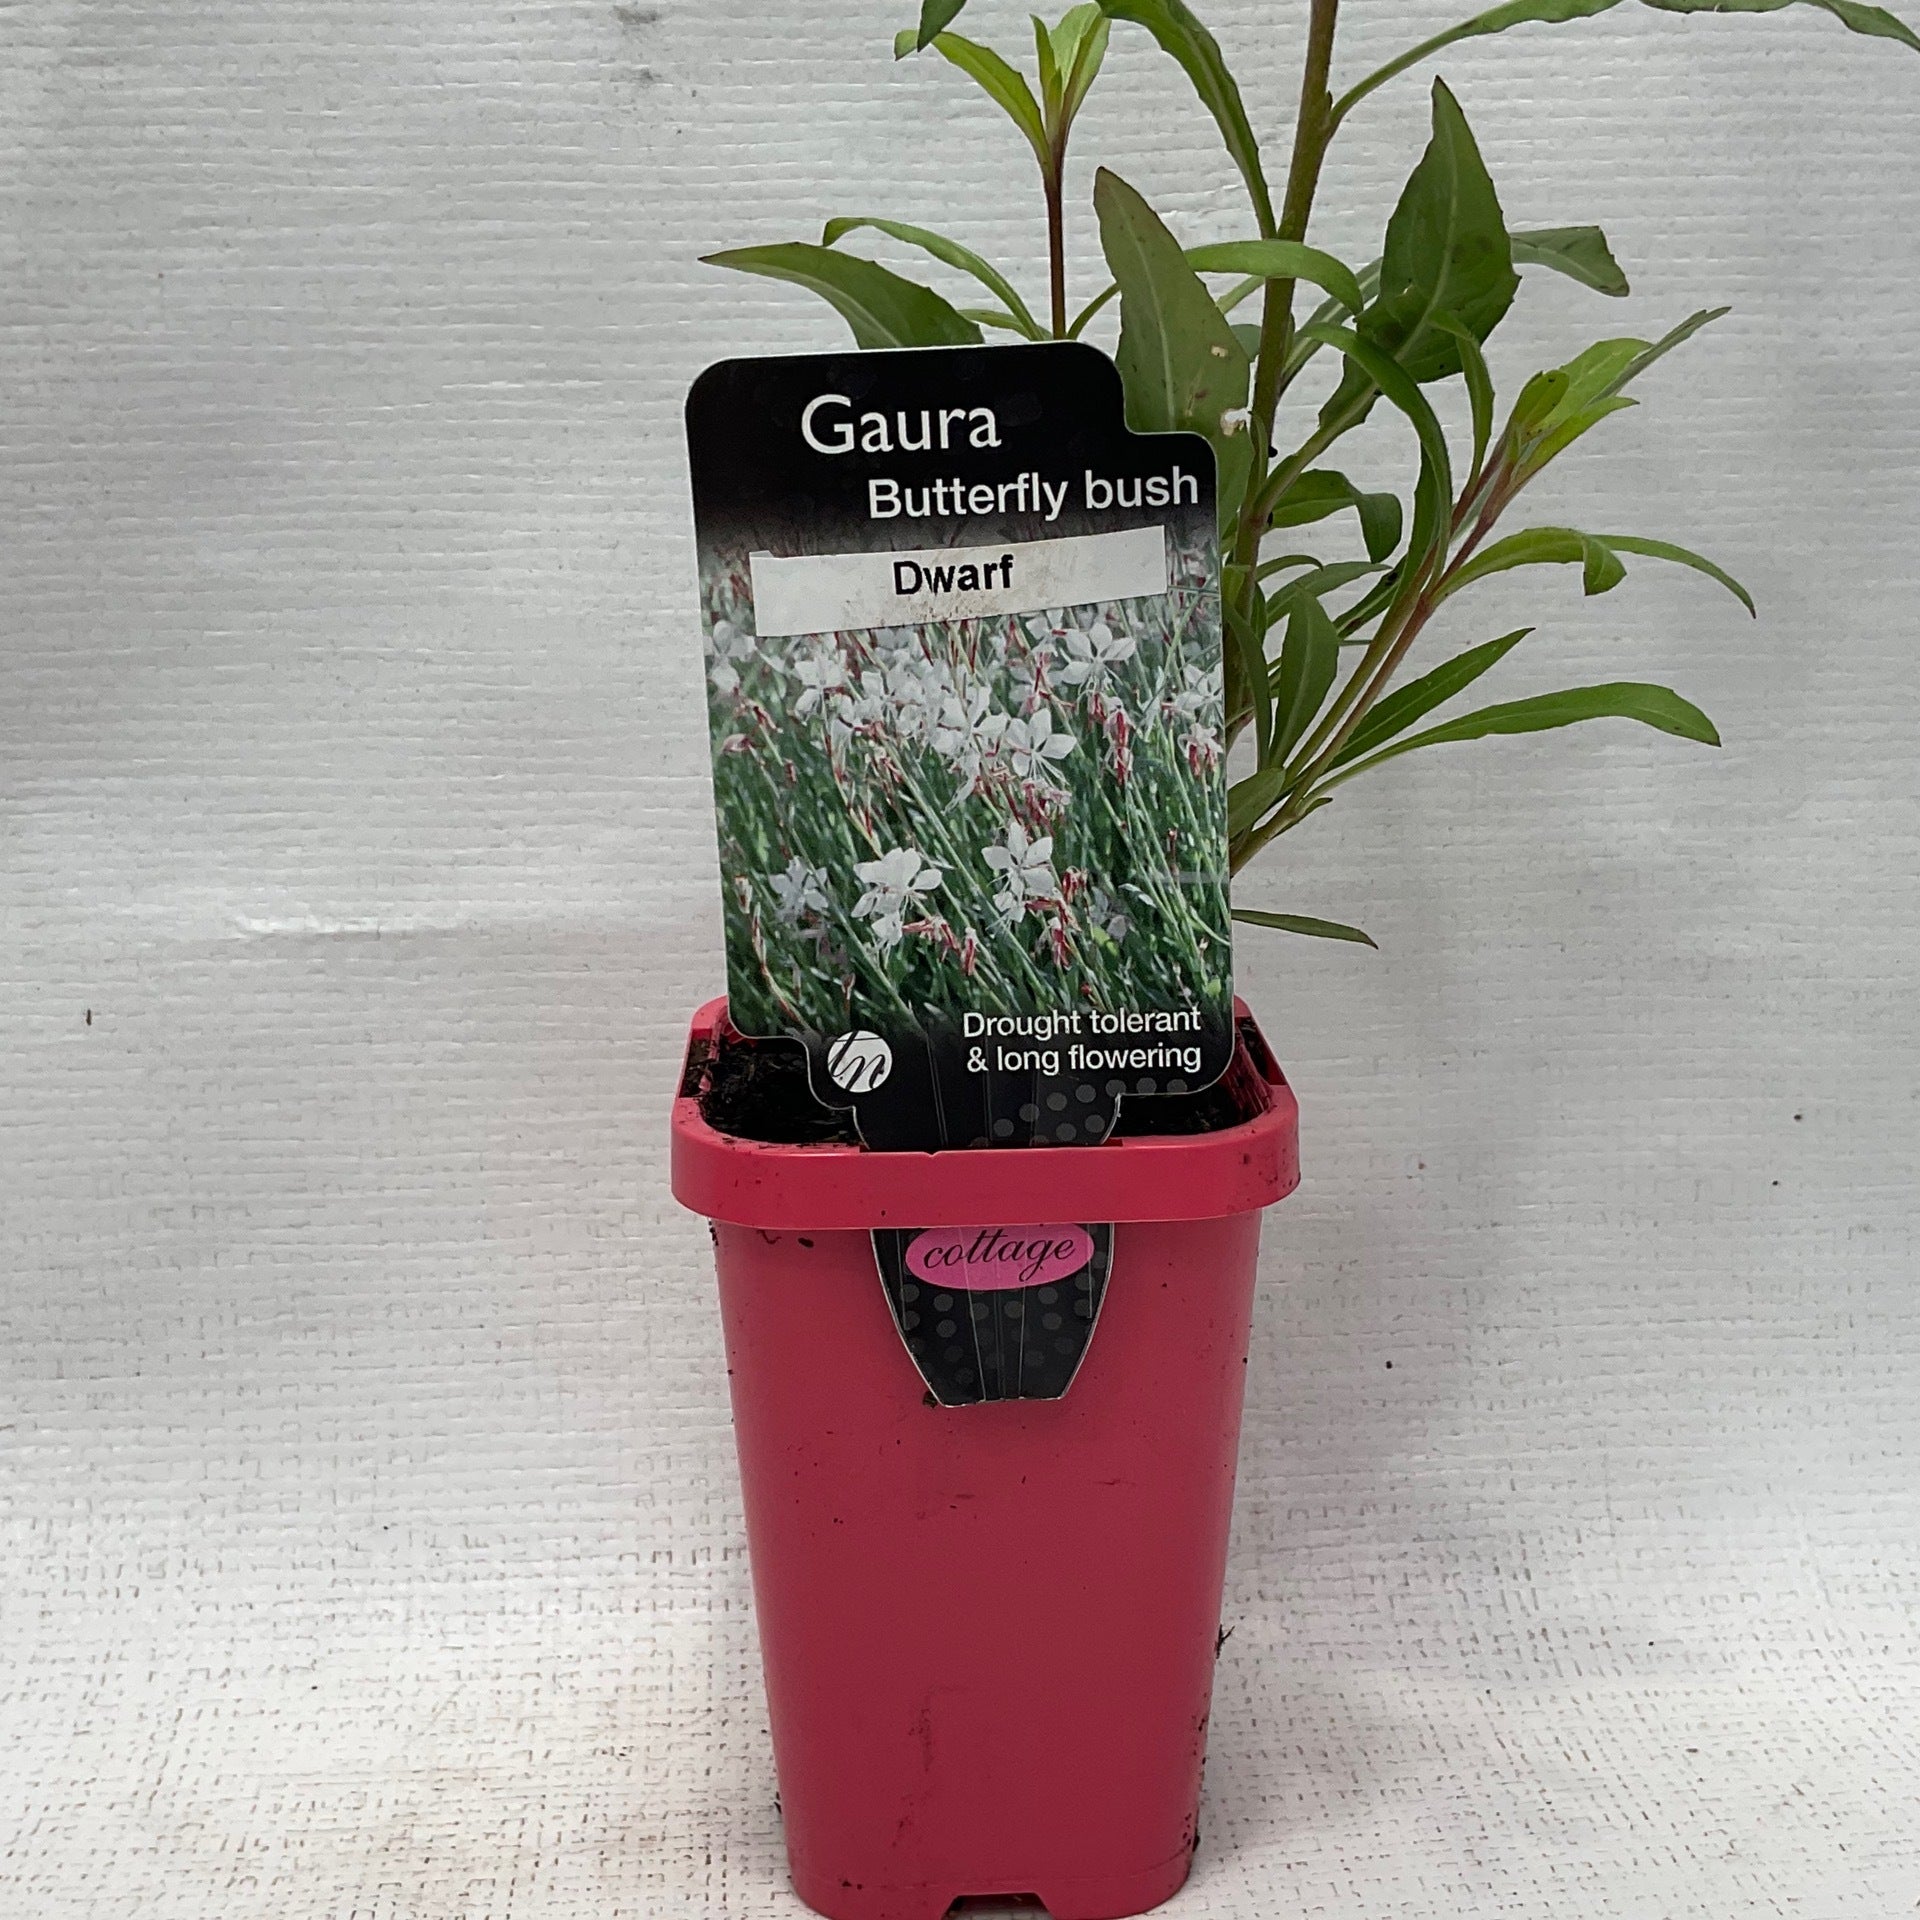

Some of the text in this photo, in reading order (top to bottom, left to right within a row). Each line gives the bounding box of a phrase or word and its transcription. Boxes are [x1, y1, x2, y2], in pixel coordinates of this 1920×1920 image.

[801, 393, 1002, 455] Gaura
[868, 466, 1199, 521] Butterfly bush
[893, 555, 1015, 596] Dwarf
[963, 1006, 1201, 1041] Drought tolerant
[967, 1042, 1201, 1075] & long flowering
[923, 1228, 1077, 1282] cottage
